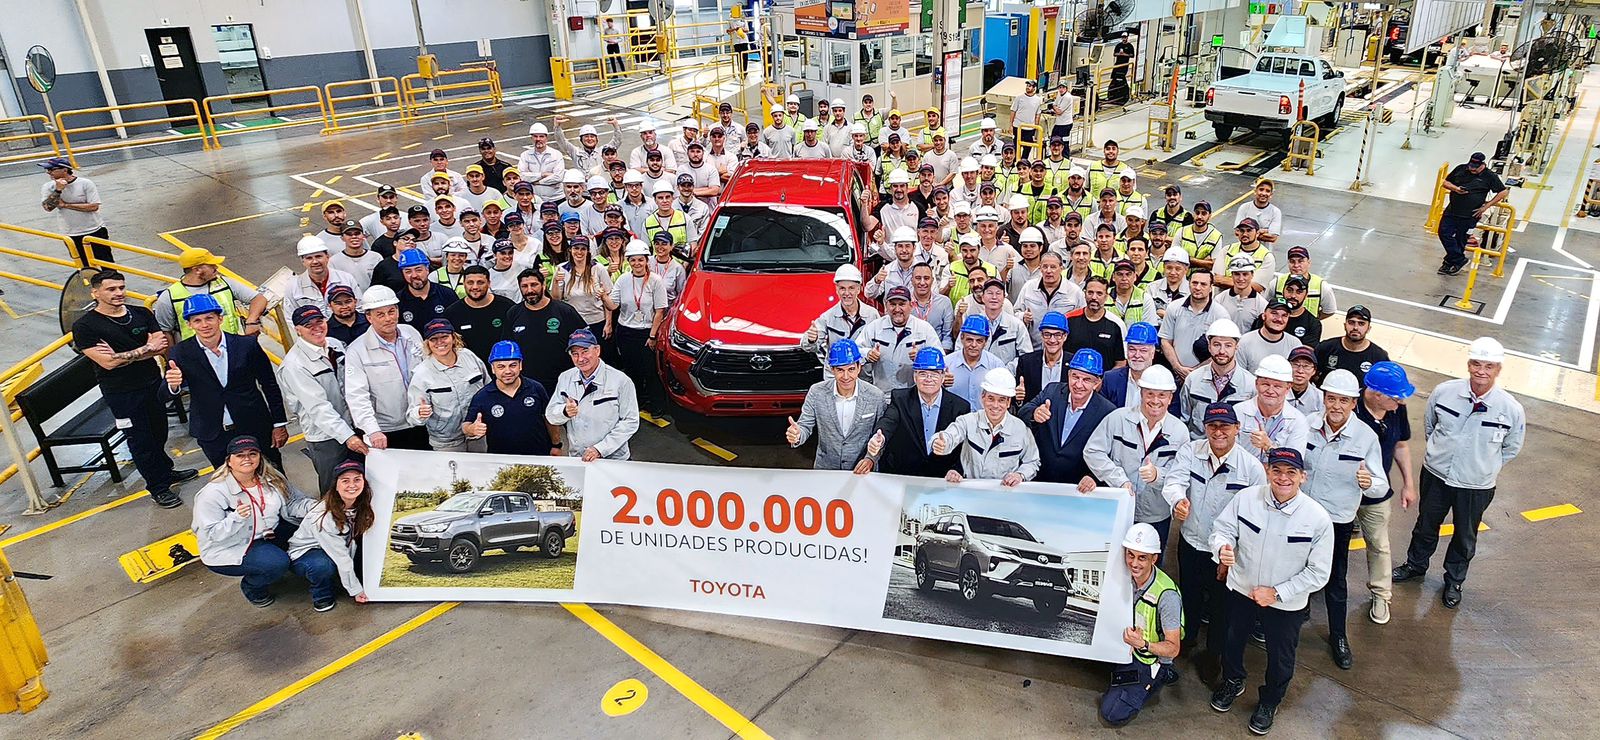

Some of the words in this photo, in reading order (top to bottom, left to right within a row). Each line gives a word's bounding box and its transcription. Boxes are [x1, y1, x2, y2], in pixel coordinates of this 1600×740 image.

[610, 486, 854, 539] 2.000.000
[600, 529, 625, 545] DE
[630, 531, 728, 552] UNIDADES
[734, 538, 868, 563] PRODUCIDAS!
[689, 579, 767, 600] TOYOTA
[614, 689, 637, 706] 2
